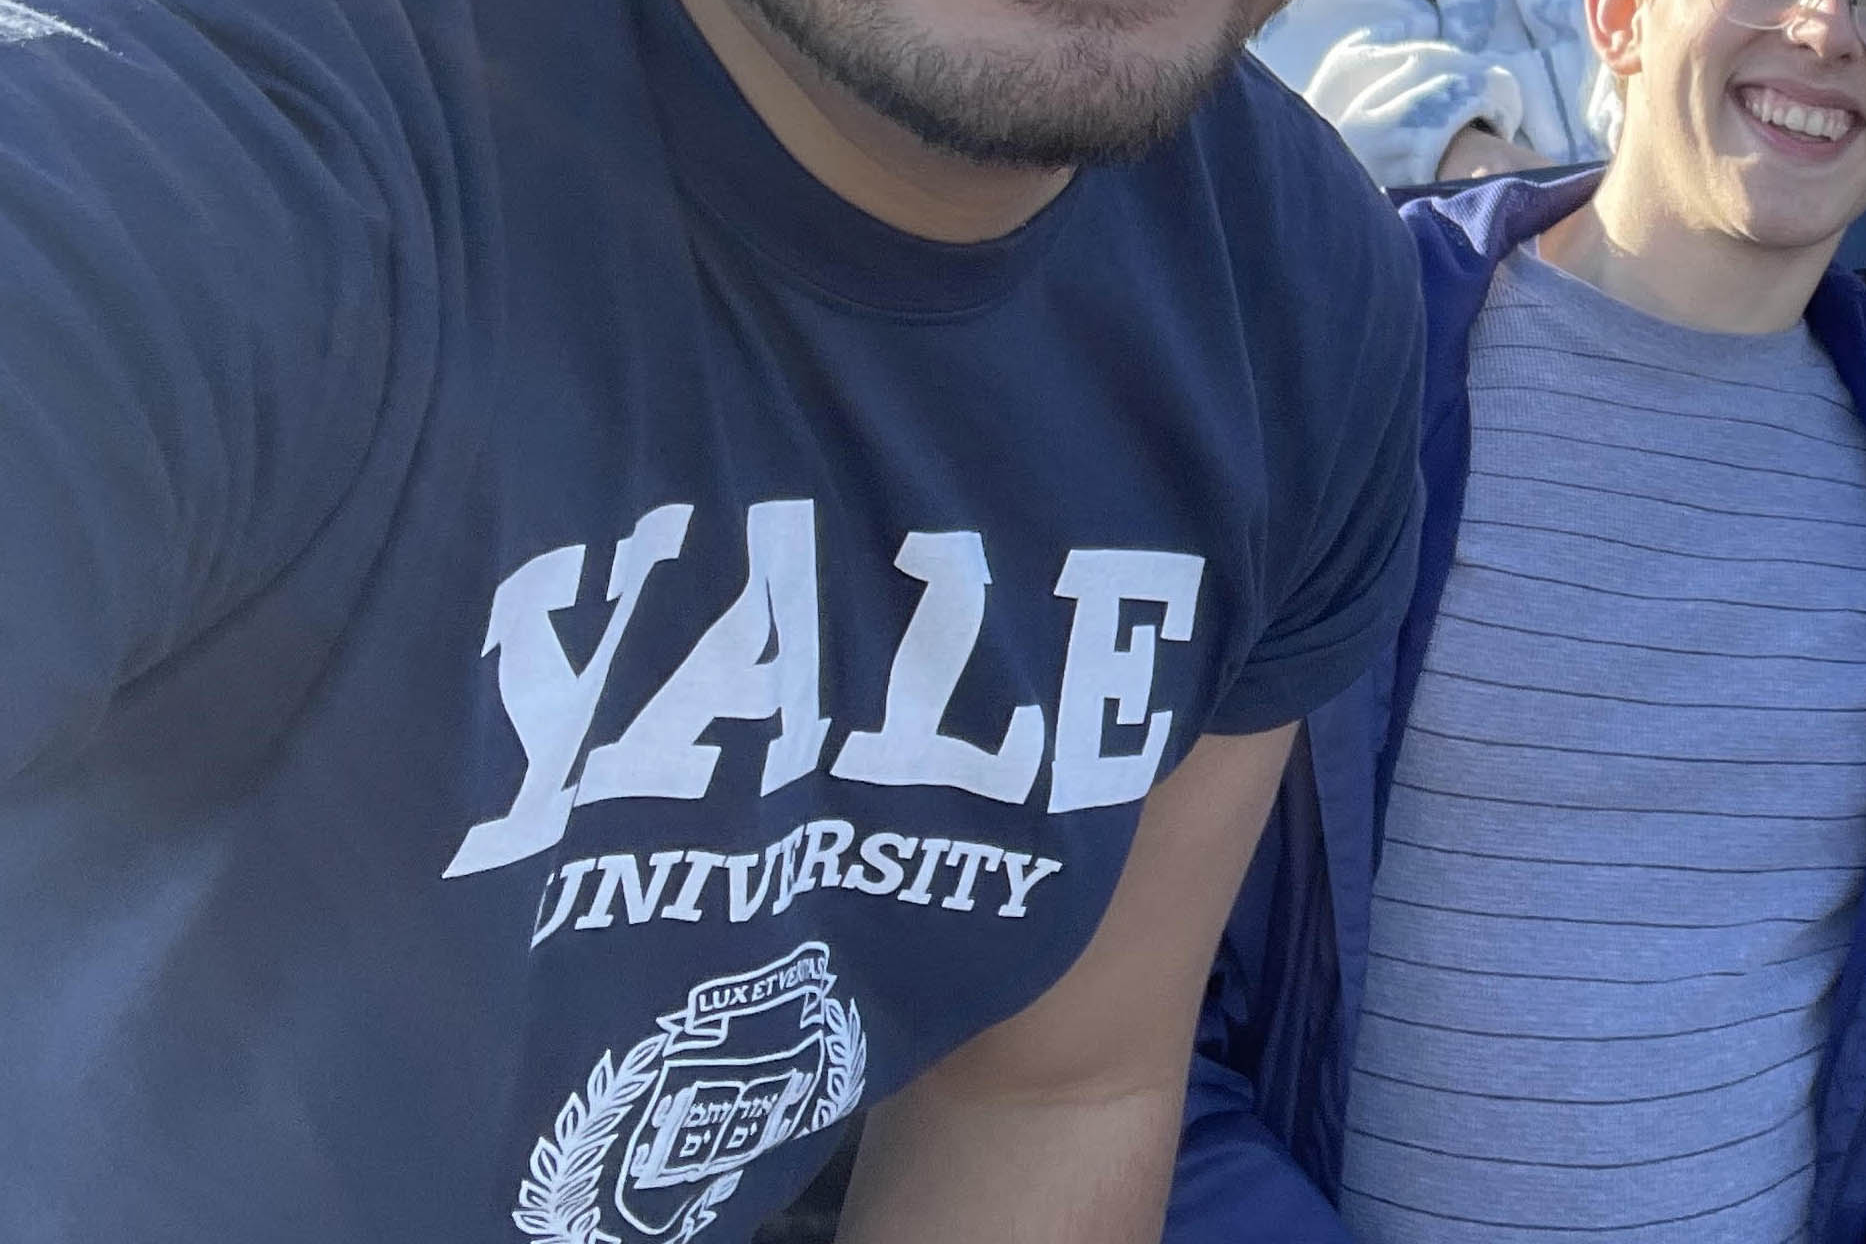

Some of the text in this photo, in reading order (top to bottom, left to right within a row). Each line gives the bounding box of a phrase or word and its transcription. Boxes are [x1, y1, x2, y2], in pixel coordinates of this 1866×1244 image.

[442, 498, 1205, 878] YALE
[530, 819, 1063, 949] UNIVERSITY
[700, 957, 826, 1012] LUX ET VEAS
